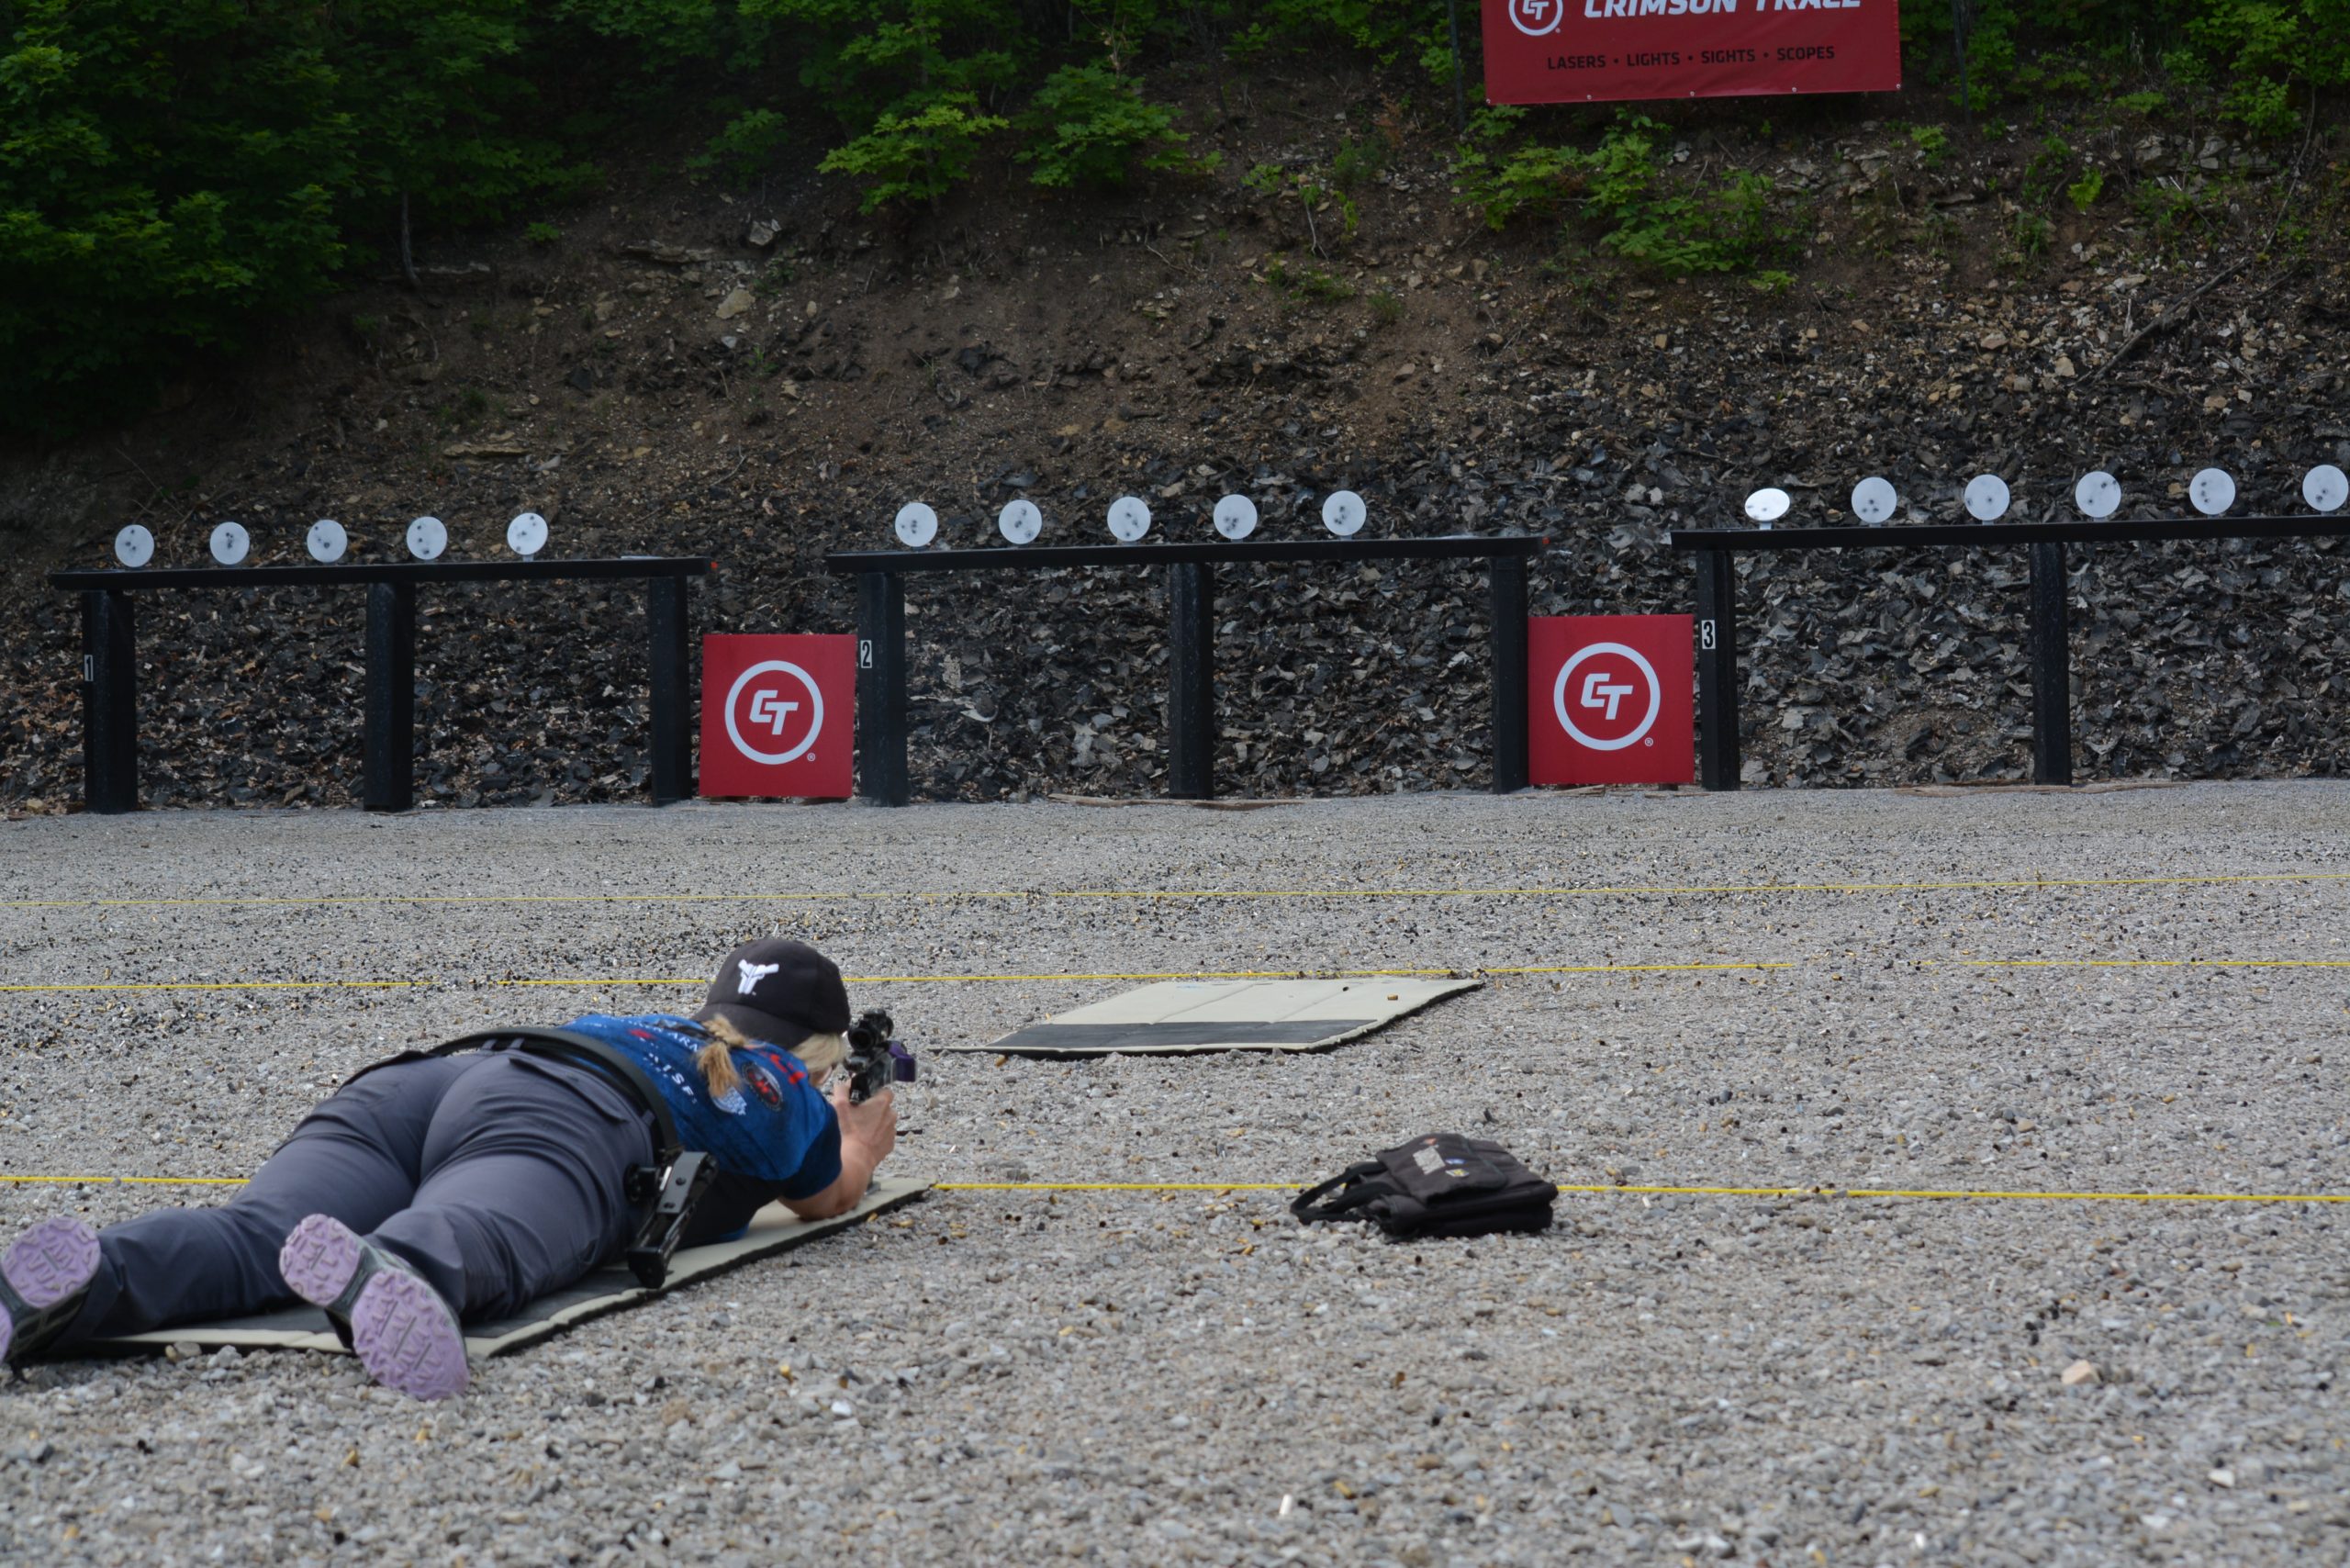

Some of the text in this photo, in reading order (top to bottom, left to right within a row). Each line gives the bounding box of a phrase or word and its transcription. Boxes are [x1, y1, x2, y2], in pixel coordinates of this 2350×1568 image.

[1547, 46, 1835, 70] LASERS LIGHTS SIGHTS SCOPES
[1703, 621, 1714, 648] 3
[861, 641, 871, 667] 2
[1580, 673, 1634, 721] CT
[749, 689, 799, 735] CT
